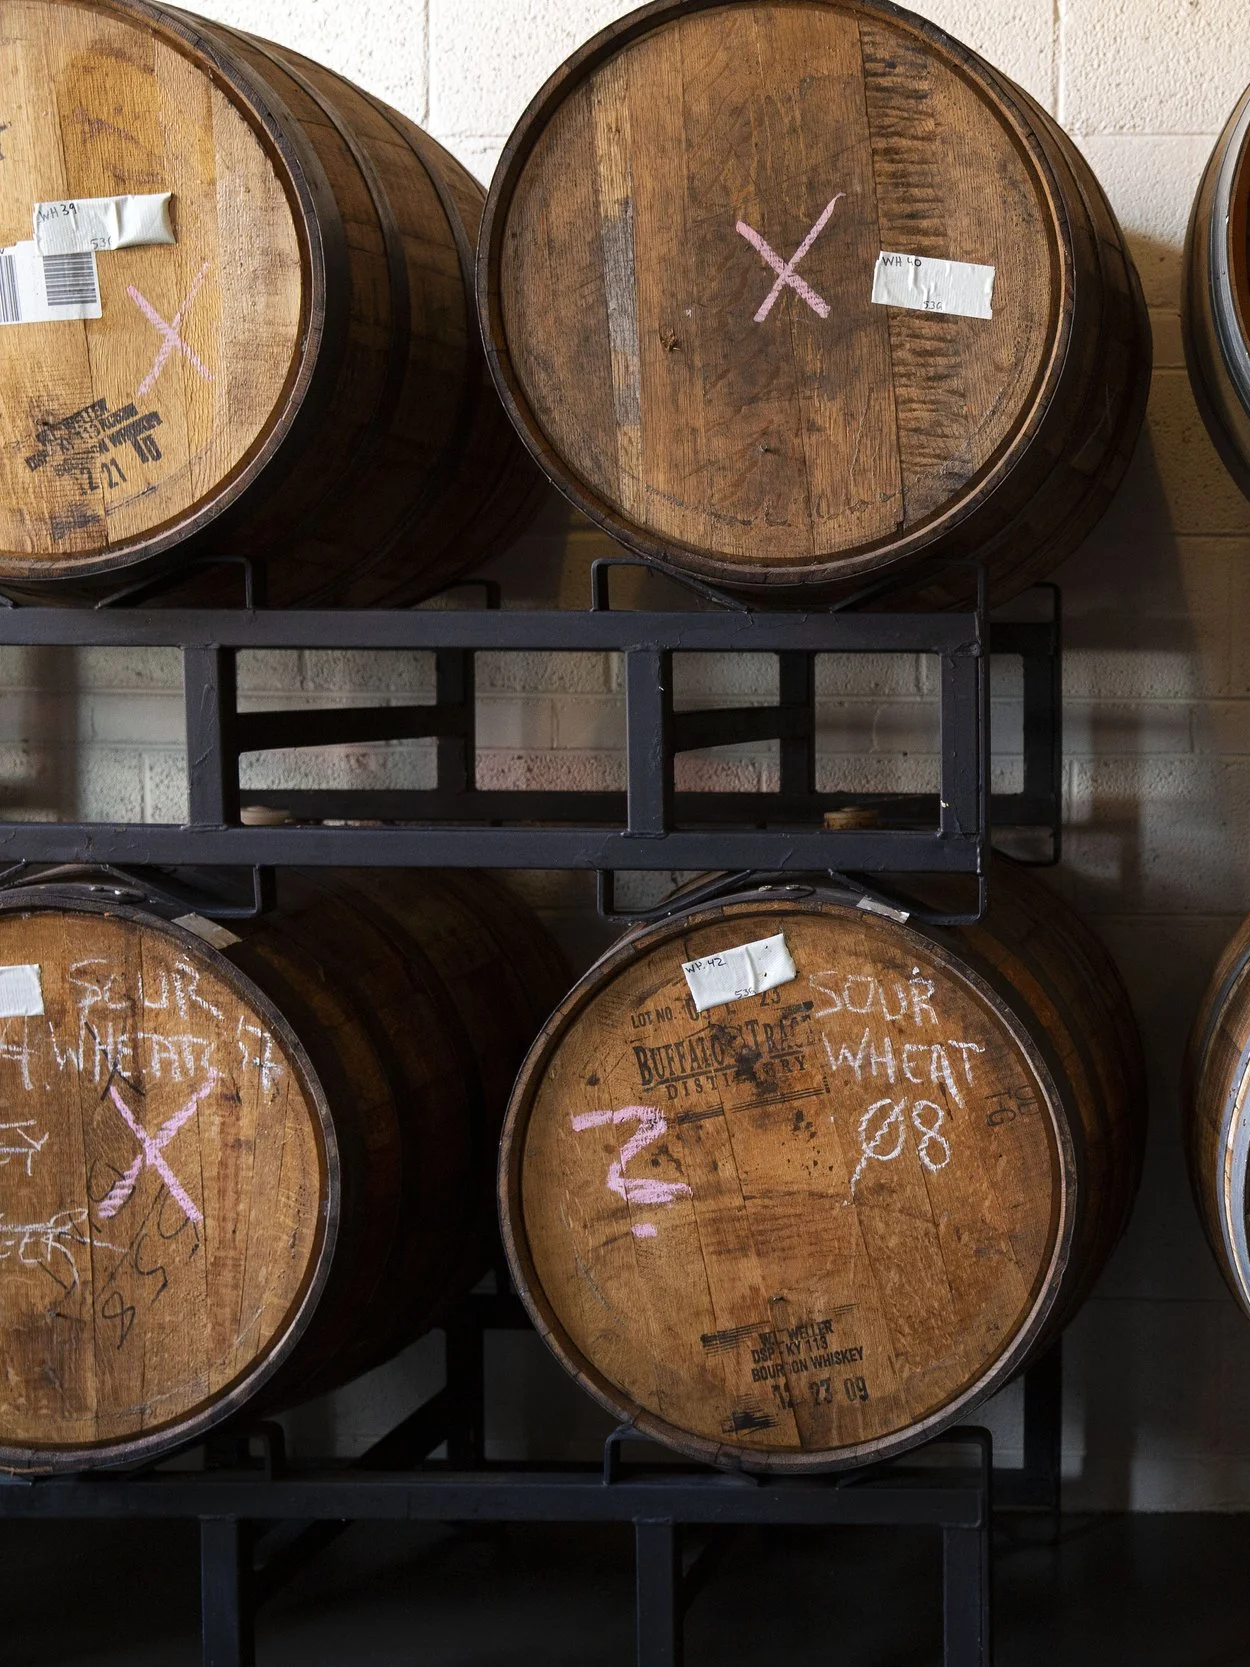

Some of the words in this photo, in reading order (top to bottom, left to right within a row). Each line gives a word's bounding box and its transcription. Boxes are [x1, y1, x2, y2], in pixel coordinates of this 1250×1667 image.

[61, 202, 78, 216] 39
[881, 255, 902, 268] WH
[906, 256, 922, 267] 40
[708, 957, 726, 968] 42
[809, 968, 939, 1027] SOUR
[631, 1012, 654, 1030] LOT
[656, 1006, 677, 1022] NO.
[821, 1027, 986, 1108] WHEAT
[751, 1347, 776, 1364] DSP
[785, 1342, 801, 1356] KY
[806, 1336, 829, 1351] 113
[811, 1346, 865, 1370] WHISKEY
[843, 1375, 870, 1402] 09
